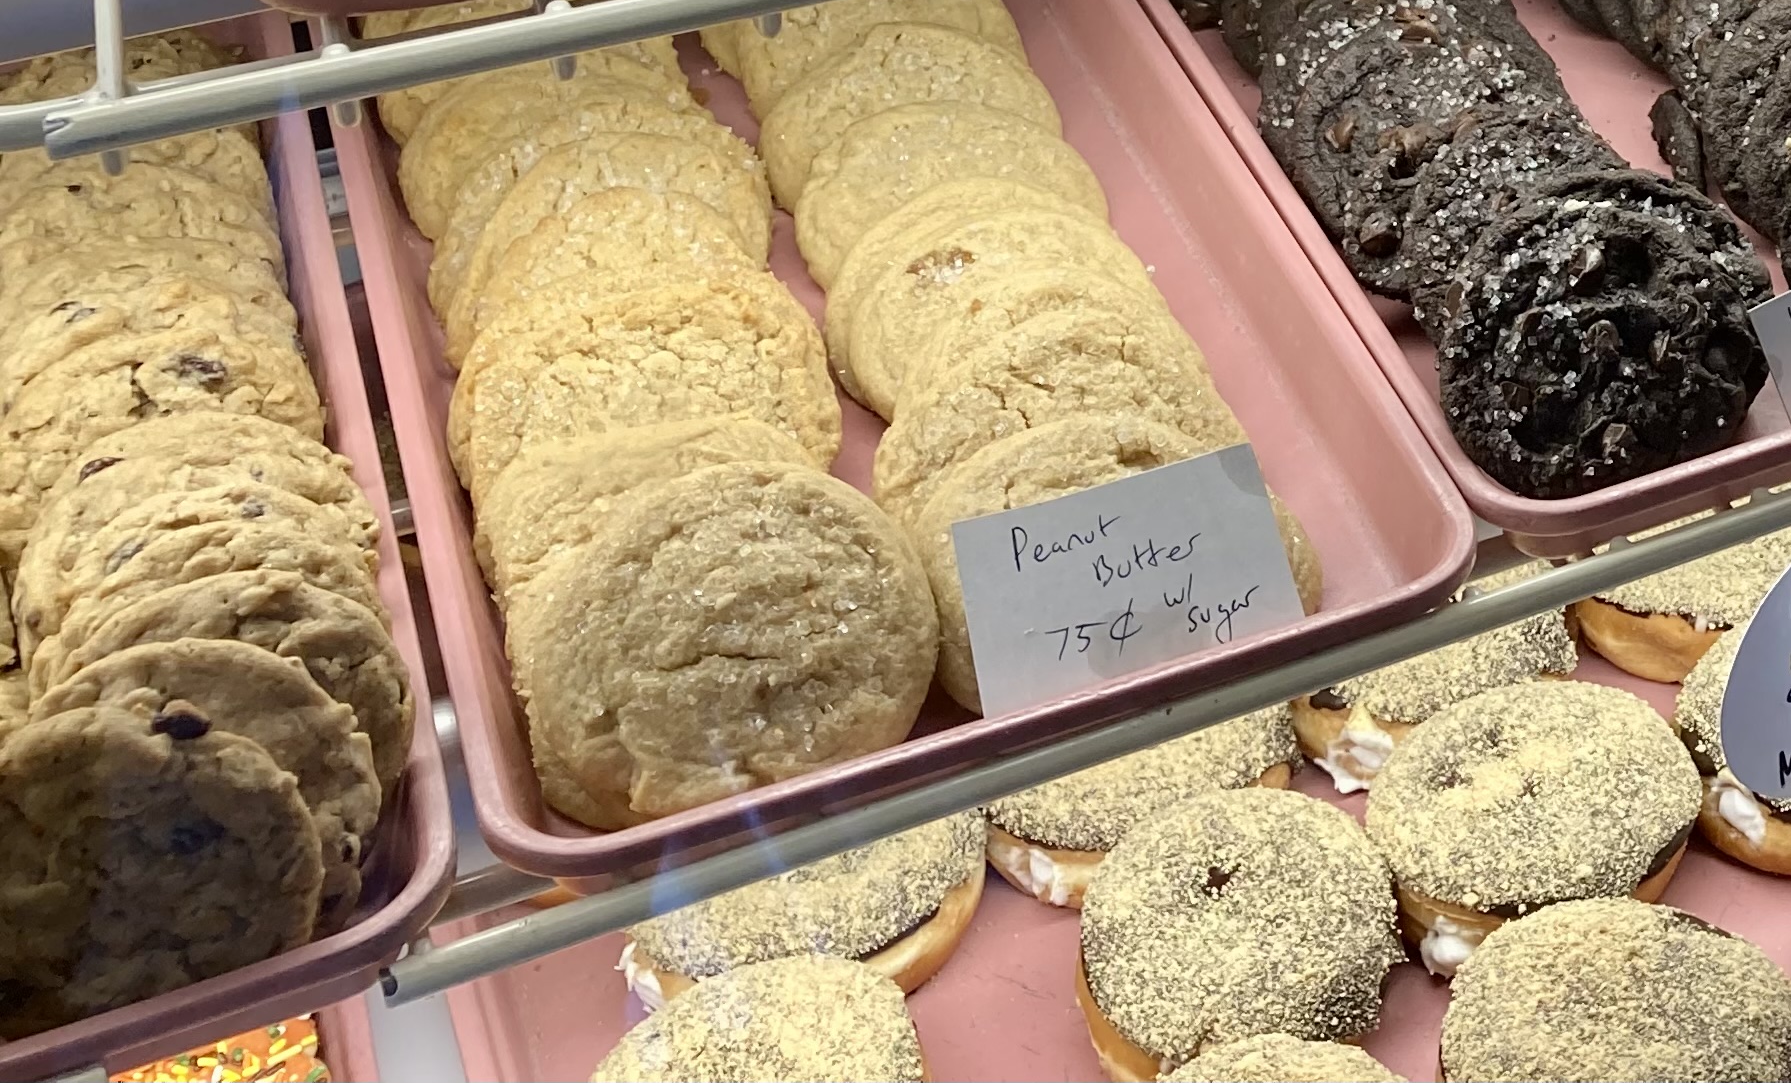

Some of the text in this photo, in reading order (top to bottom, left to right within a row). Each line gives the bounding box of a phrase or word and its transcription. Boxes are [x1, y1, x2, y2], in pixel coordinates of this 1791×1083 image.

[1011, 514, 1122, 572] Peanut
[1092, 532, 1202, 589] Butter
[1045, 598, 1143, 661] 75¢
[1187, 584, 1261, 644] sugar
